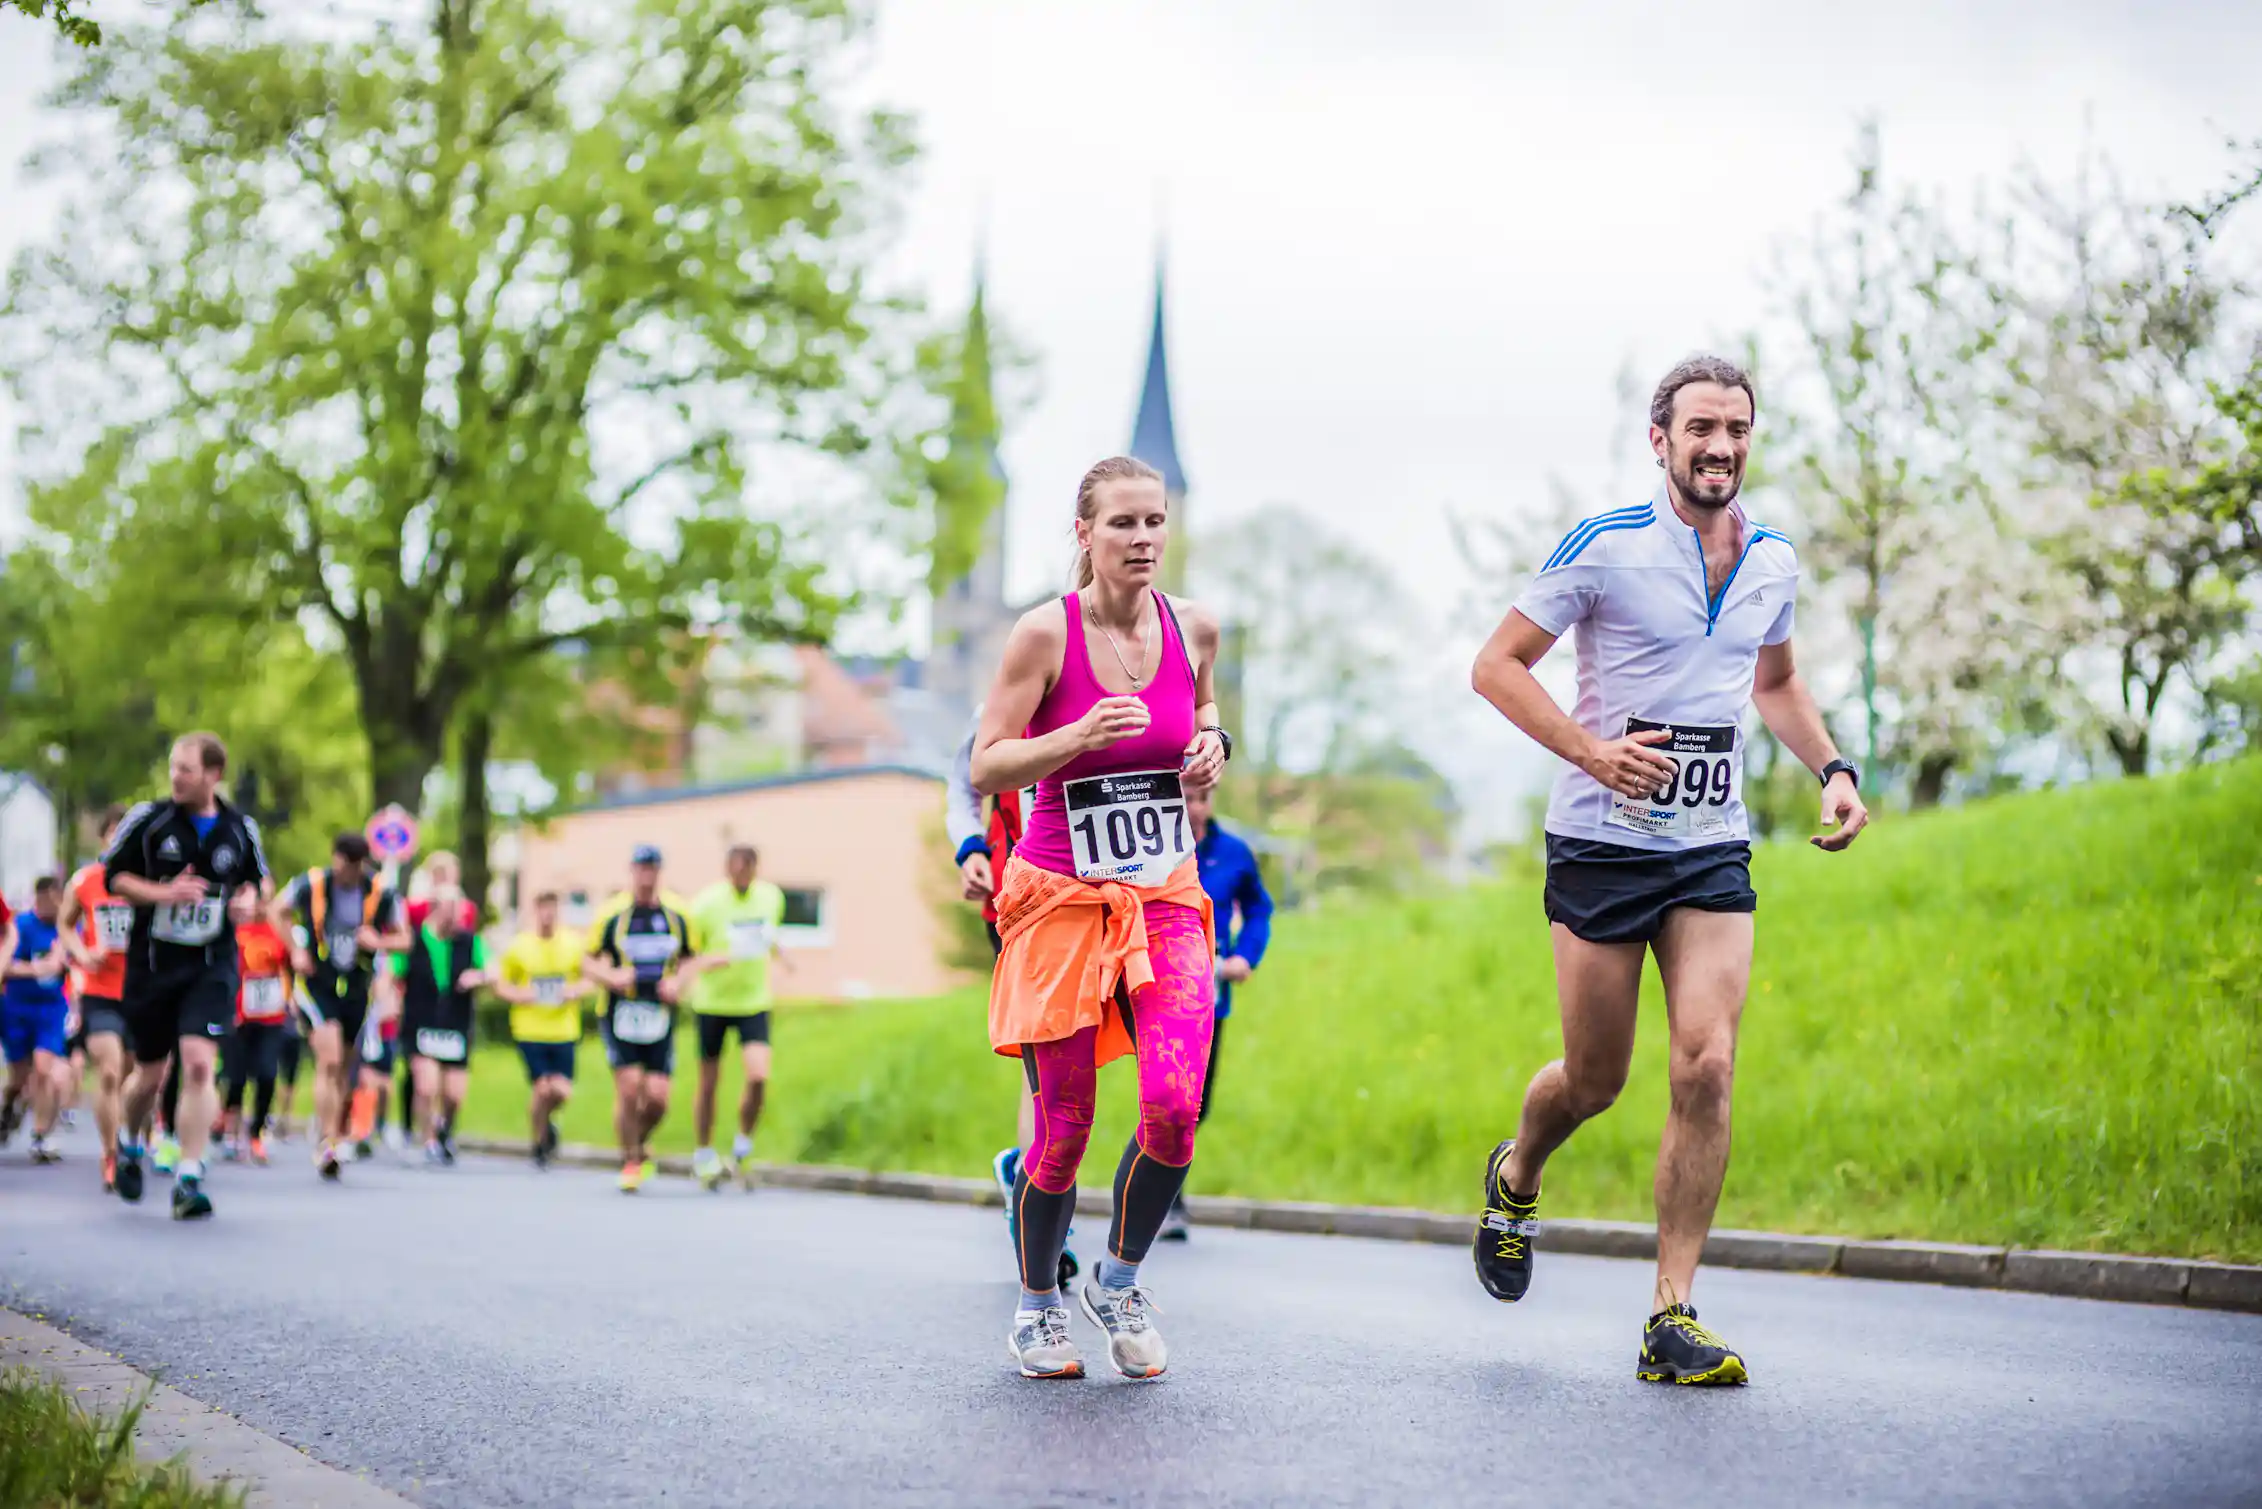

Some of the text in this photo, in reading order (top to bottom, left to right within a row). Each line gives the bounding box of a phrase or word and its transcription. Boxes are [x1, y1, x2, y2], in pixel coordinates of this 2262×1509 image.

[1675, 731, 1711, 742] Sparkasse
[1673, 742, 1706, 752] Bamberg
[1115, 782, 1151, 792] Sparkasse
[1650, 756, 1731, 808] 099
[1117, 792, 1150, 801] Bamberg
[1623, 804, 1677, 820] INTERSPORT
[1622, 812, 1668, 827] PROFIMARKT
[1074, 805, 1184, 865] 1097
[1090, 863, 1144, 877] INTERSPORT
